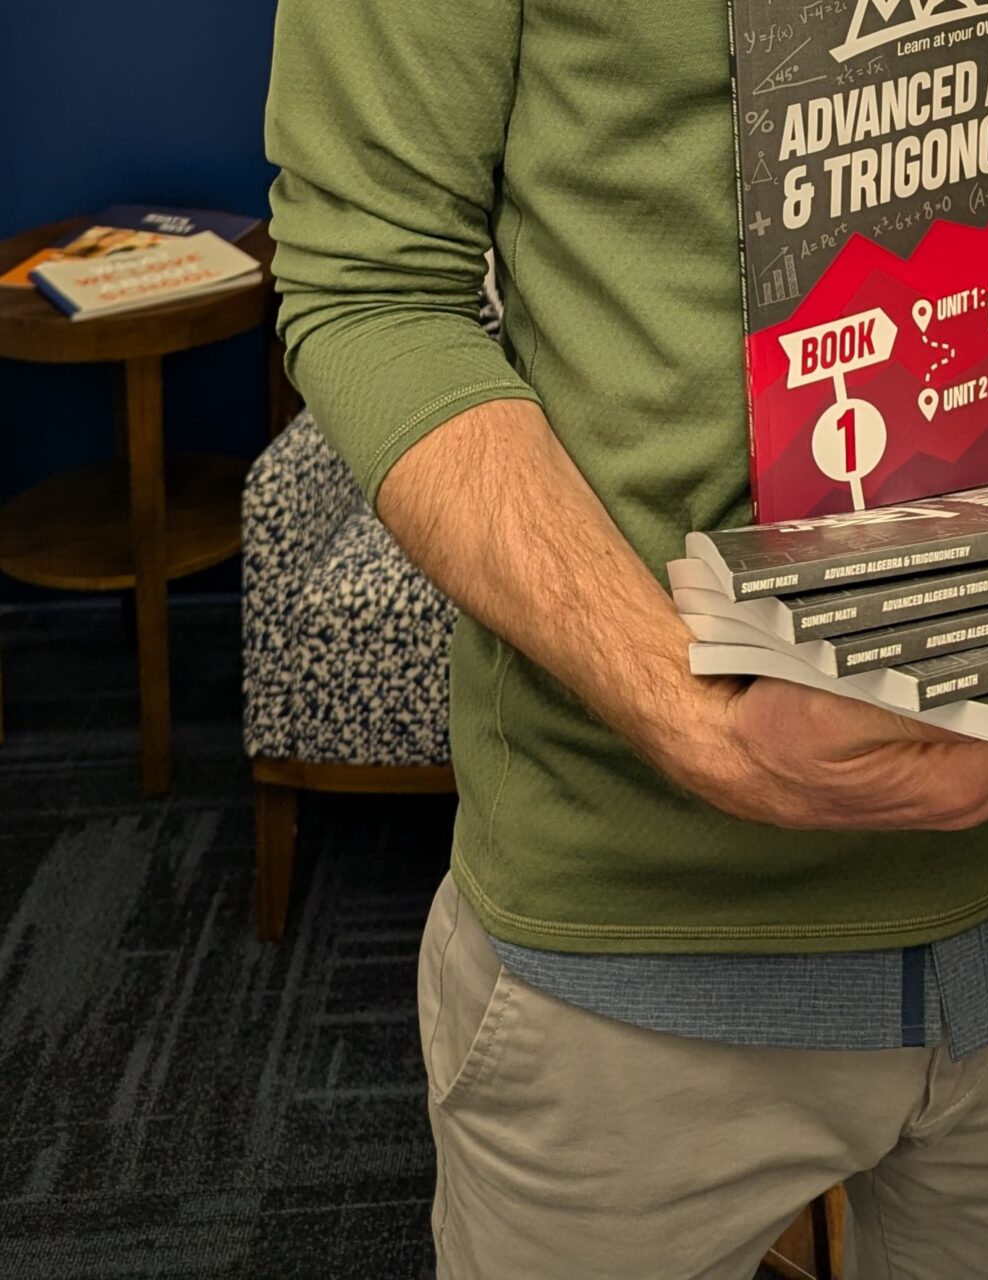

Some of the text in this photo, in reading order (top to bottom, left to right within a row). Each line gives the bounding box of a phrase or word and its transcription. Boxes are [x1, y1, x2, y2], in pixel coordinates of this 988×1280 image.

[897, 37, 929, 56] Learn
[933, 33, 946, 48] at
[947, 28, 972, 47] your
[779, 60, 978, 161] ADVANCED
[783, 165, 814, 230] &
[936, 289, 970, 320] UNIT
[801, 318, 876, 376] BOOK
[943, 380, 977, 411] UNIT
[836, 408, 857, 473] 1
[741, 577, 775, 594] SUMMIT
[775, 574, 798, 589] MATH
[824, 563, 866, 580] ADVANCED
[867, 557, 902, 574] ALGEBRA
[911, 546, 971, 566] TRIGONOMETRY
[801, 611, 834, 629] SUMMIT
[834, 607, 857, 623] MATH
[882, 595, 924, 612] ADVANCED
[924, 588, 959, 606] ALGEBRA
[846, 649, 879, 666] SUMMIT
[879, 644, 902, 659] MATH
[926, 631, 966, 649] ADVANCED
[926, 681, 957, 698] SUMMIT
[957, 674, 979, 690] MATH
